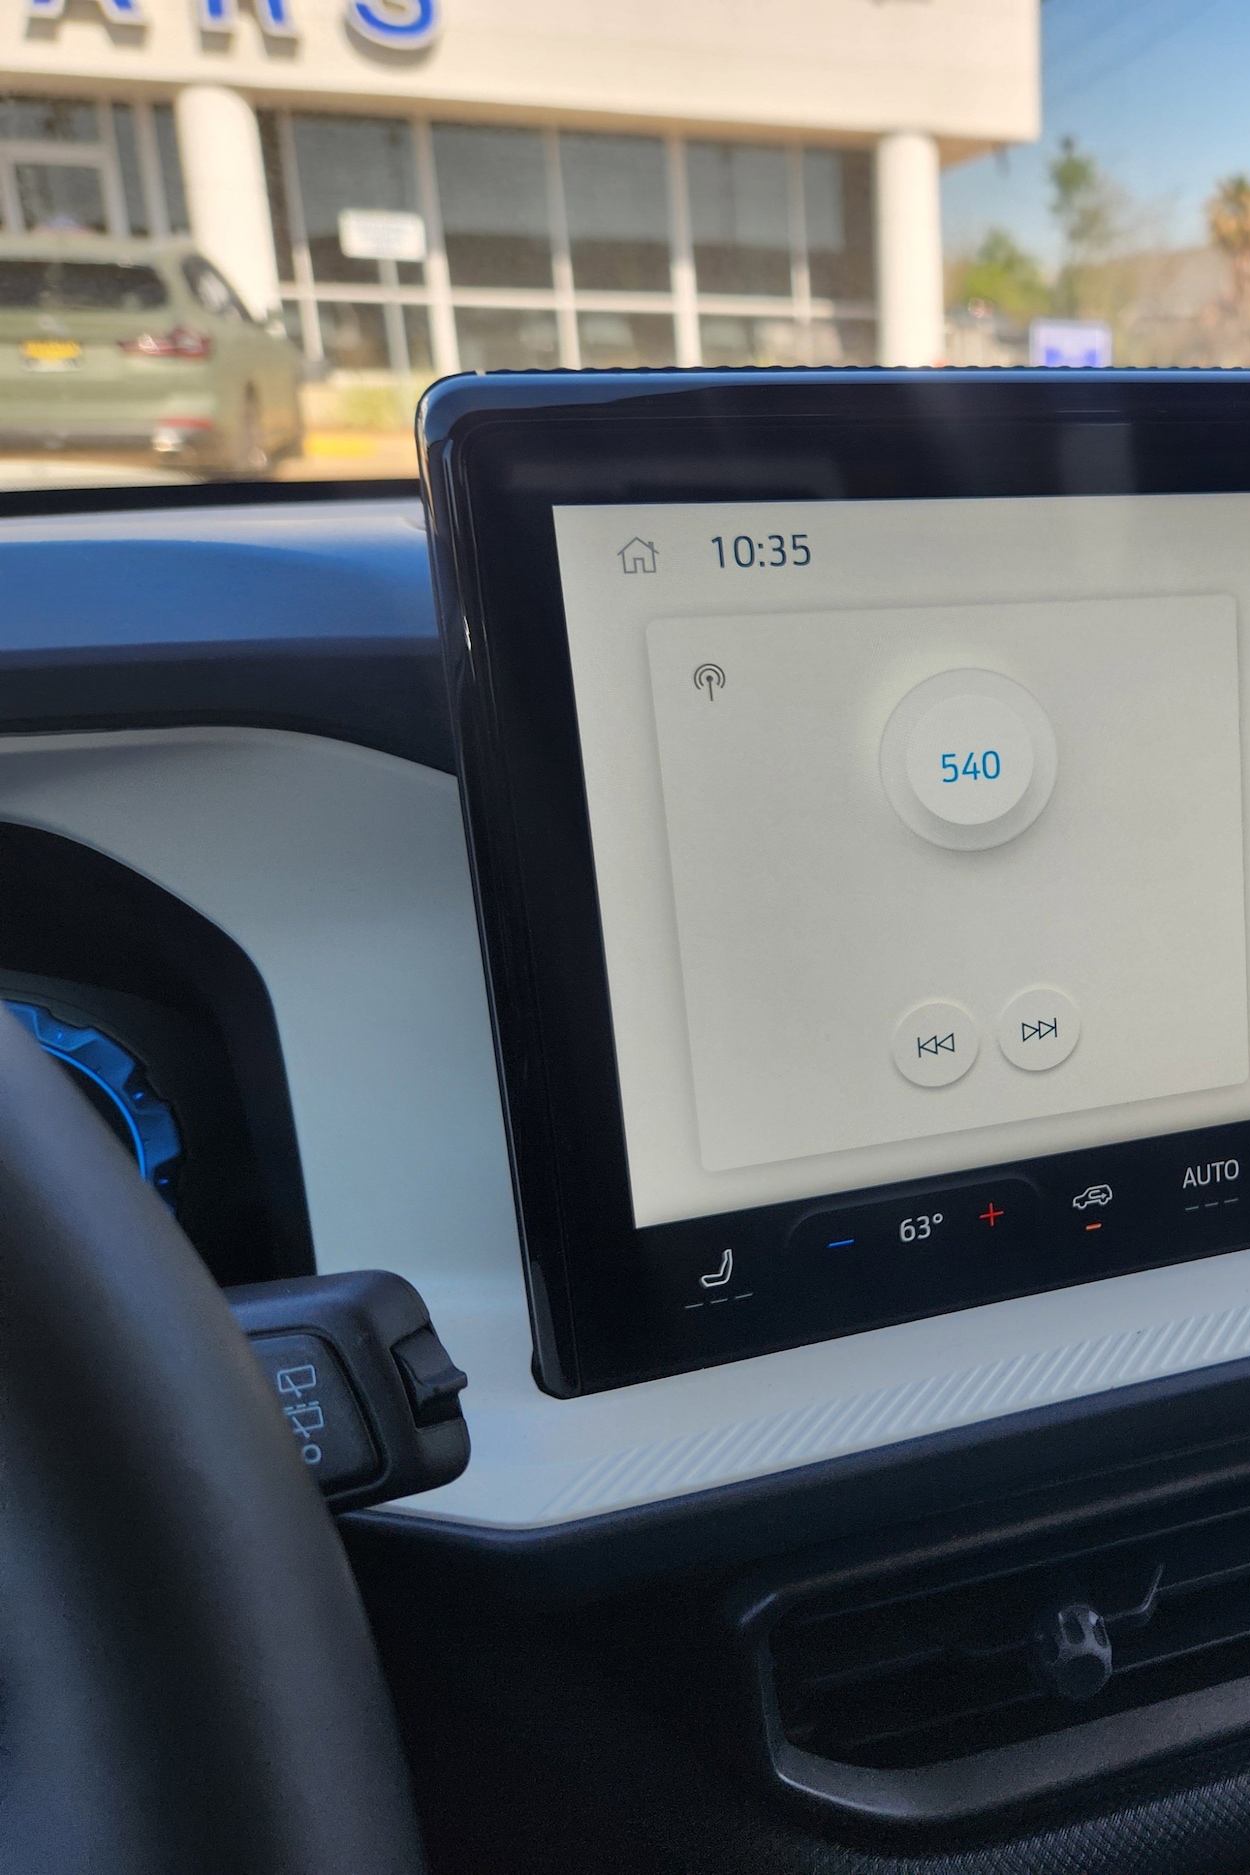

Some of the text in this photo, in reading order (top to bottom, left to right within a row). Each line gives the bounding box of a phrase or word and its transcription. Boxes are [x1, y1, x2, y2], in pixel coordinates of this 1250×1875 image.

[710, 533, 812, 569] 10:35
[940, 749, 1001, 784] 540
[1182, 1158, 1241, 1189] AUTO
